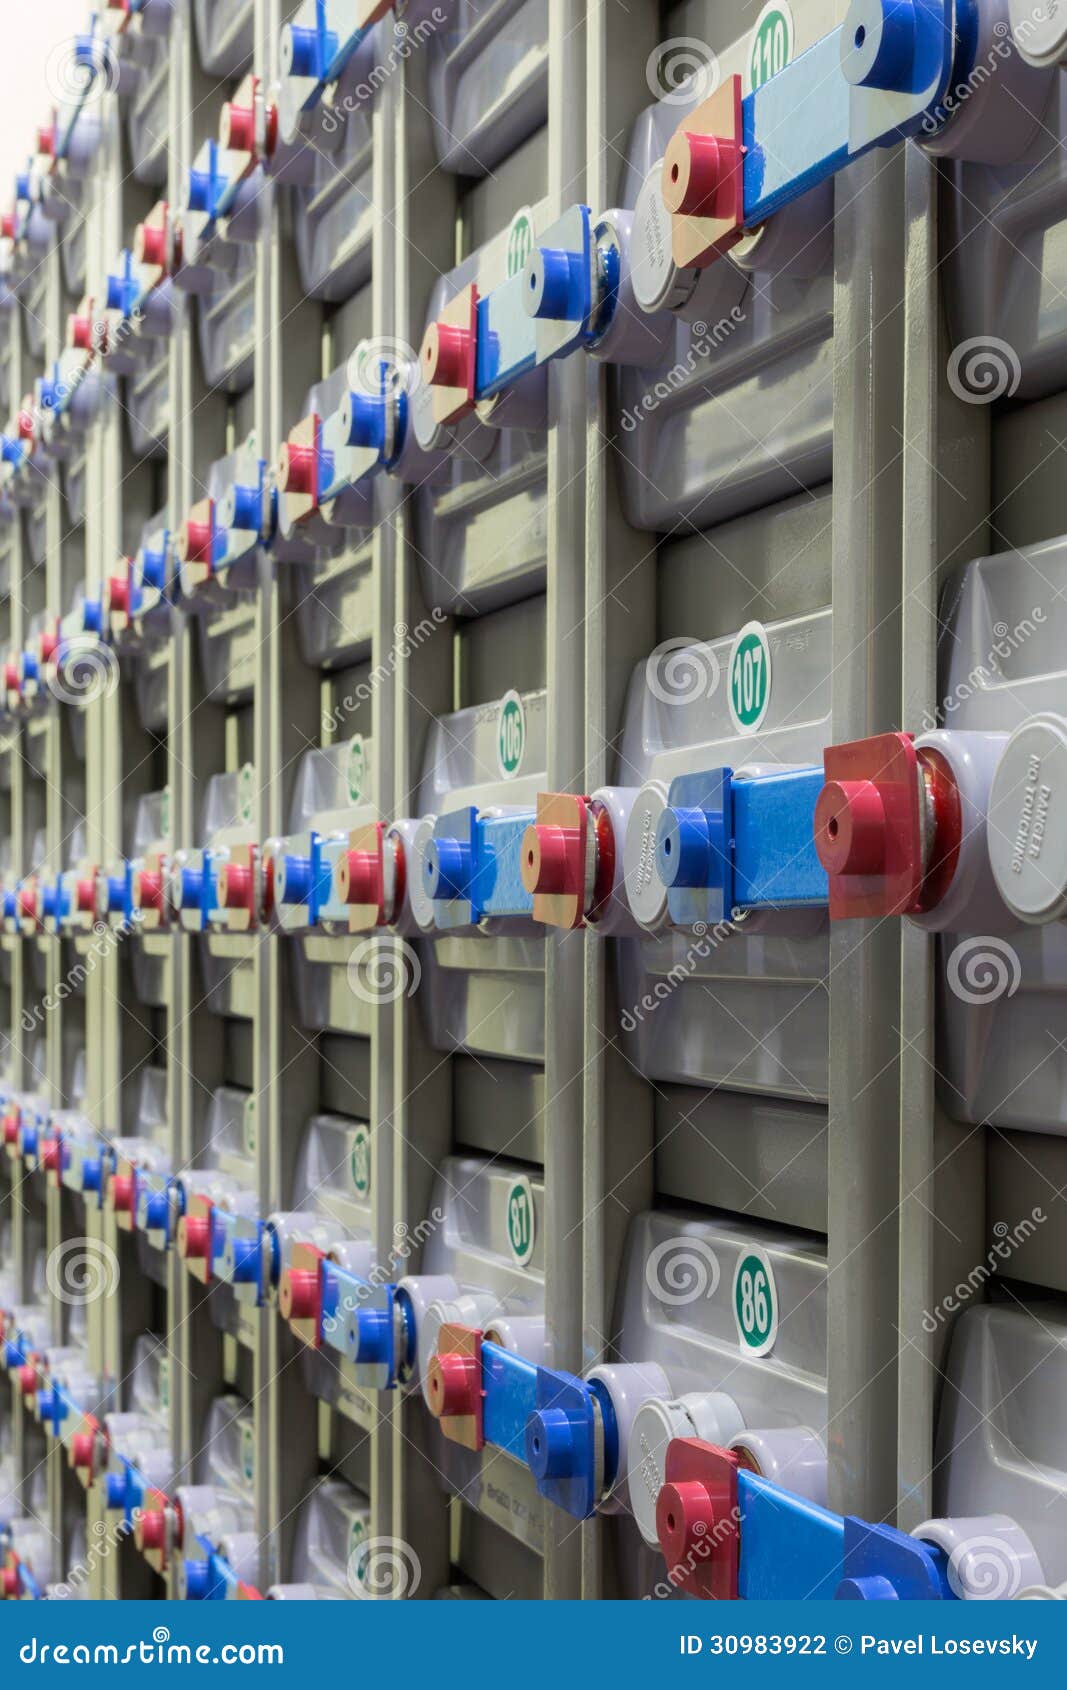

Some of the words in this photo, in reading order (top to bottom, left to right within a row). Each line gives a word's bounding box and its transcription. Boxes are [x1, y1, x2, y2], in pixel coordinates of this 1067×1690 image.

[753, 19, 785, 88] 110
[734, 644, 763, 715] 107
[502, 710, 520, 763] 106
[1029, 754, 1041, 783] NO
[1011, 785, 1036, 875] TOUCHING
[1029, 784, 1051, 859] DANGER
[511, 1193, 527, 1248] 87
[741, 1270, 768, 1334] 86
